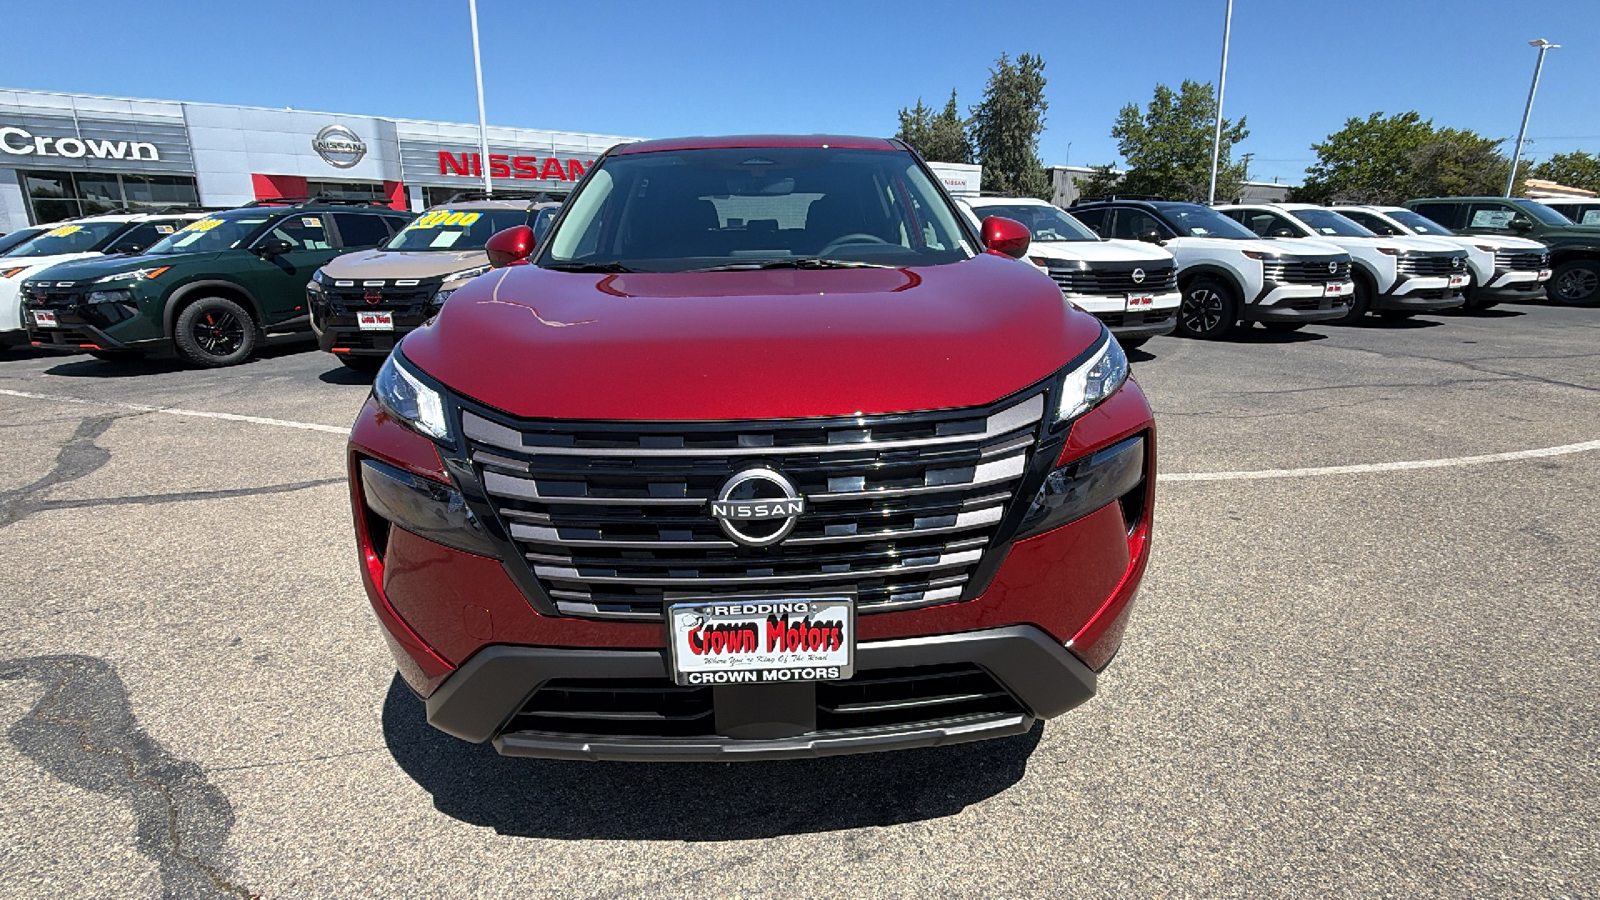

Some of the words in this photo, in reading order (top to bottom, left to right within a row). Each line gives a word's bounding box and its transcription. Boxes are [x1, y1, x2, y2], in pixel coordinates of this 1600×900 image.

[0, 127, 159, 161] Crown
[317, 141, 361, 151] NISSAN
[438, 151, 595, 182] NISSAN
[712, 501, 803, 517] NISSAN
[714, 603, 809, 616] REDDING
[688, 621, 759, 655] Crown
[766, 613, 844, 653] Motors
[703, 656, 727, 665] Where
[756, 655, 775, 664] King
[778, 654, 789, 664] Of
[791, 653, 804, 662] The
[689, 670, 758, 684] CROWN
[762, 667, 840, 682] MOTORS
